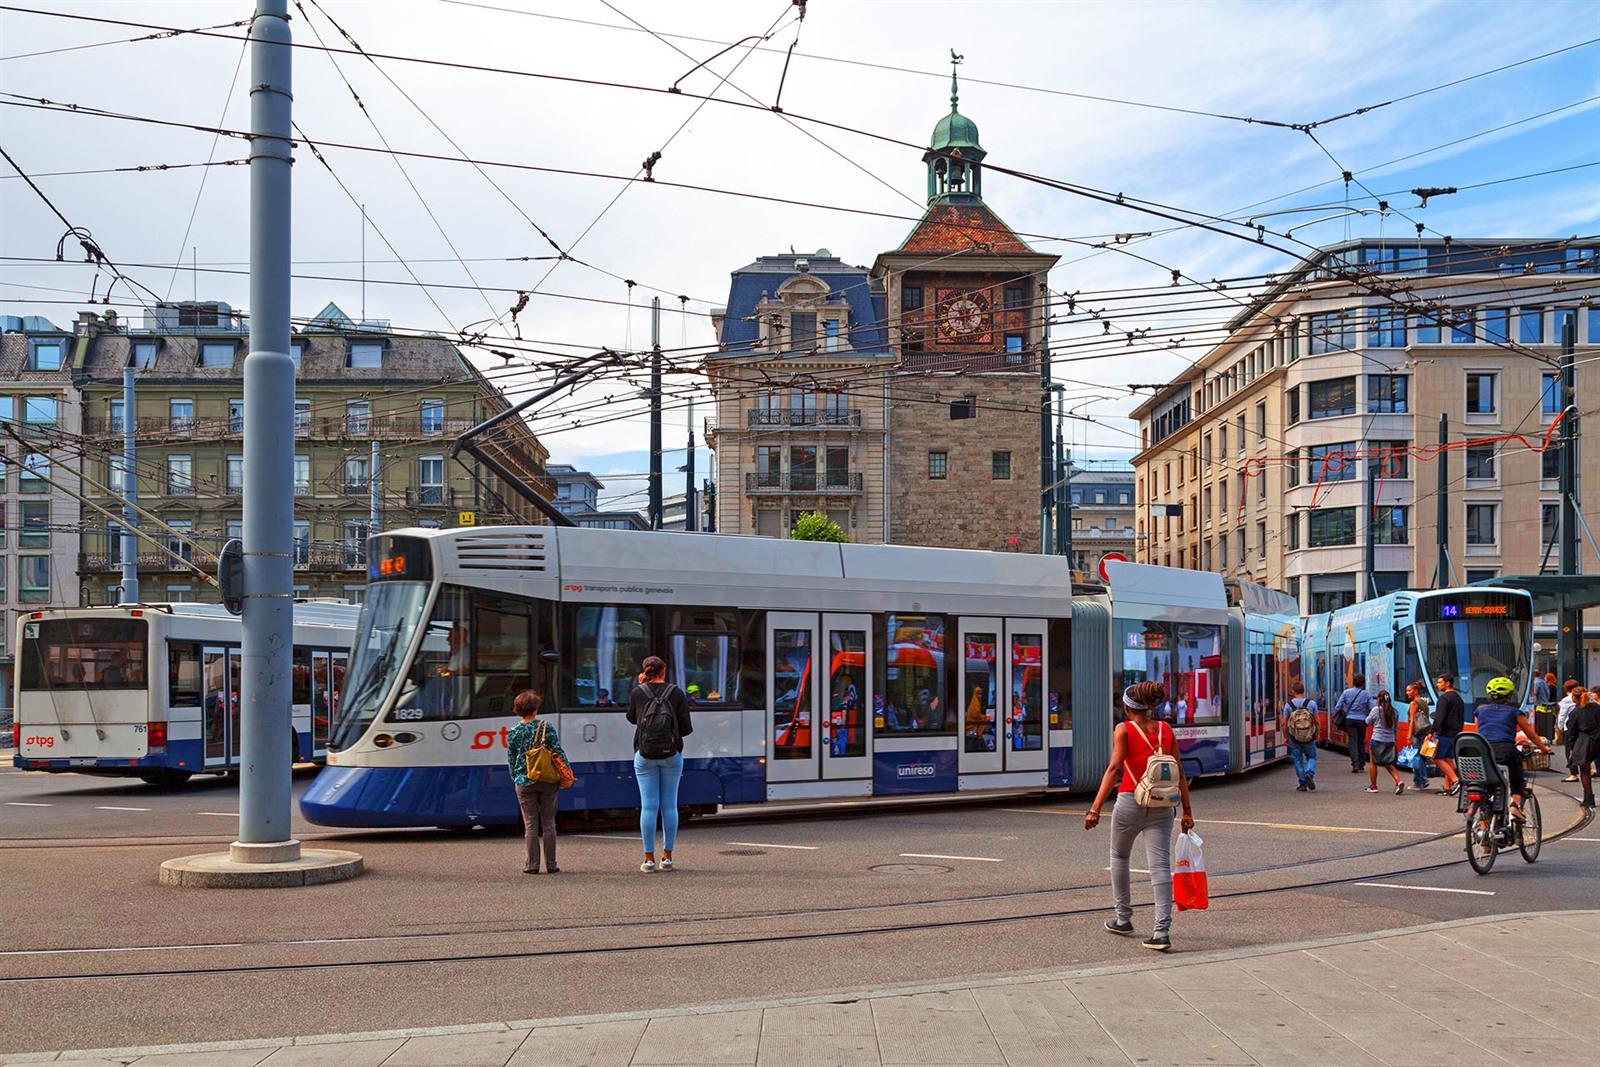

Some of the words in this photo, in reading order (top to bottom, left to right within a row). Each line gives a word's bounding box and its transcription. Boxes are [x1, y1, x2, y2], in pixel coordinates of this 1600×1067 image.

[1443, 605, 1457, 616] 14
[1129, 633, 1138, 647] 14
[394, 709, 423, 719] 1829
[134, 725, 147, 733] 761
[898, 766, 934, 776] unireso
